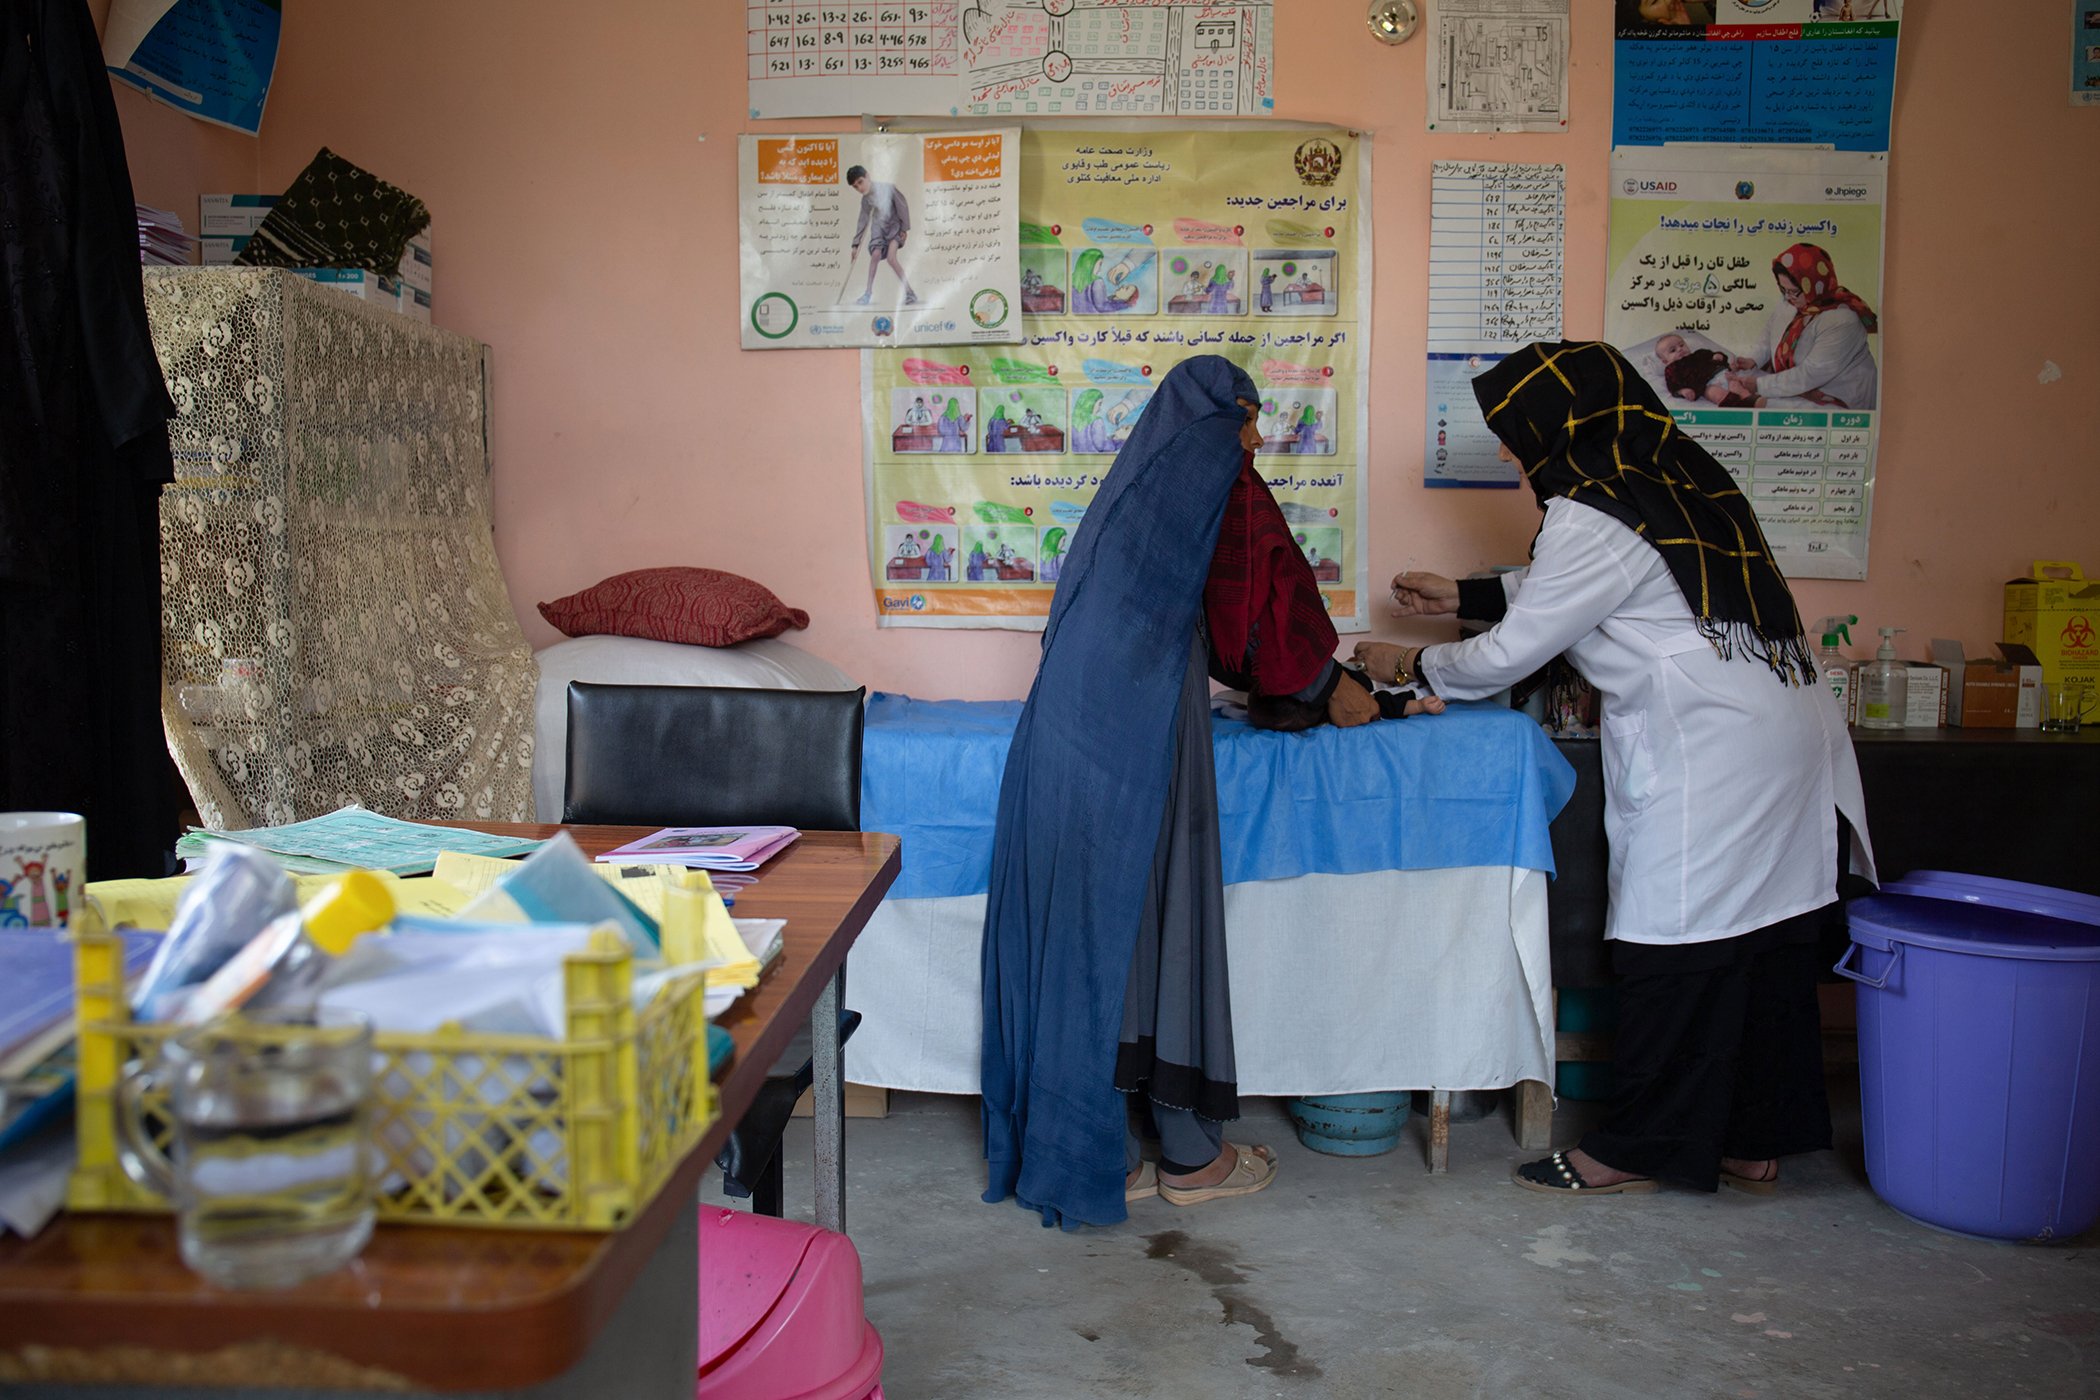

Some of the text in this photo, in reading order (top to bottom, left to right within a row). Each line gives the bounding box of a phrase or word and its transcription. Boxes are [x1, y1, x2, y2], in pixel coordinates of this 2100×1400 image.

[796, 34, 816, 47] 162
[855, 33, 874, 46] 162
[908, 33, 927, 46] 578
[1536, 25, 1548, 42] T5
[1469, 52, 1481, 69] T2
[1496, 45, 1508, 62] T3
[909, 57, 930, 69] 465
[1521, 66, 1533, 84] T4
[1076, 146, 1152, 157] وزارت صحت عامه
[1093, 159, 1171, 172] ریاست عمومی طب
[1066, 173, 1161, 185] اداره ملی معافیت کتلوی
[1640, 181, 1678, 192] USAID
[1834, 186, 1867, 199] Jhpiego
[1226, 195, 1347, 210] برای مراجعین جدید:
[1659, 215, 1838, 238] واکسین زنده گی را نجات میدهد!
[1639, 254, 1750, 271] طفل تان را قبل از یک
[1629, 272, 1756, 296] سالگی ۵ مرتبه در مرکز
[1620, 296, 1764, 315] صحی در اوقات ذیل واکسین
[914, 320, 943, 333] unicef
[1030, 326, 1346, 347] اگر مراجعین از جمله کسانی باشند که قبلاً کارت واکسین
[1783, 413, 1861, 425] دوره زمان
[1010, 474, 1041, 489] باشد:
[1044, 474, 1087, 489] گردیده
[1310, 474, 1344, 488] آنعده
[883, 597, 909, 609] Gavi
[2064, 676, 2096, 684] KOJAK
